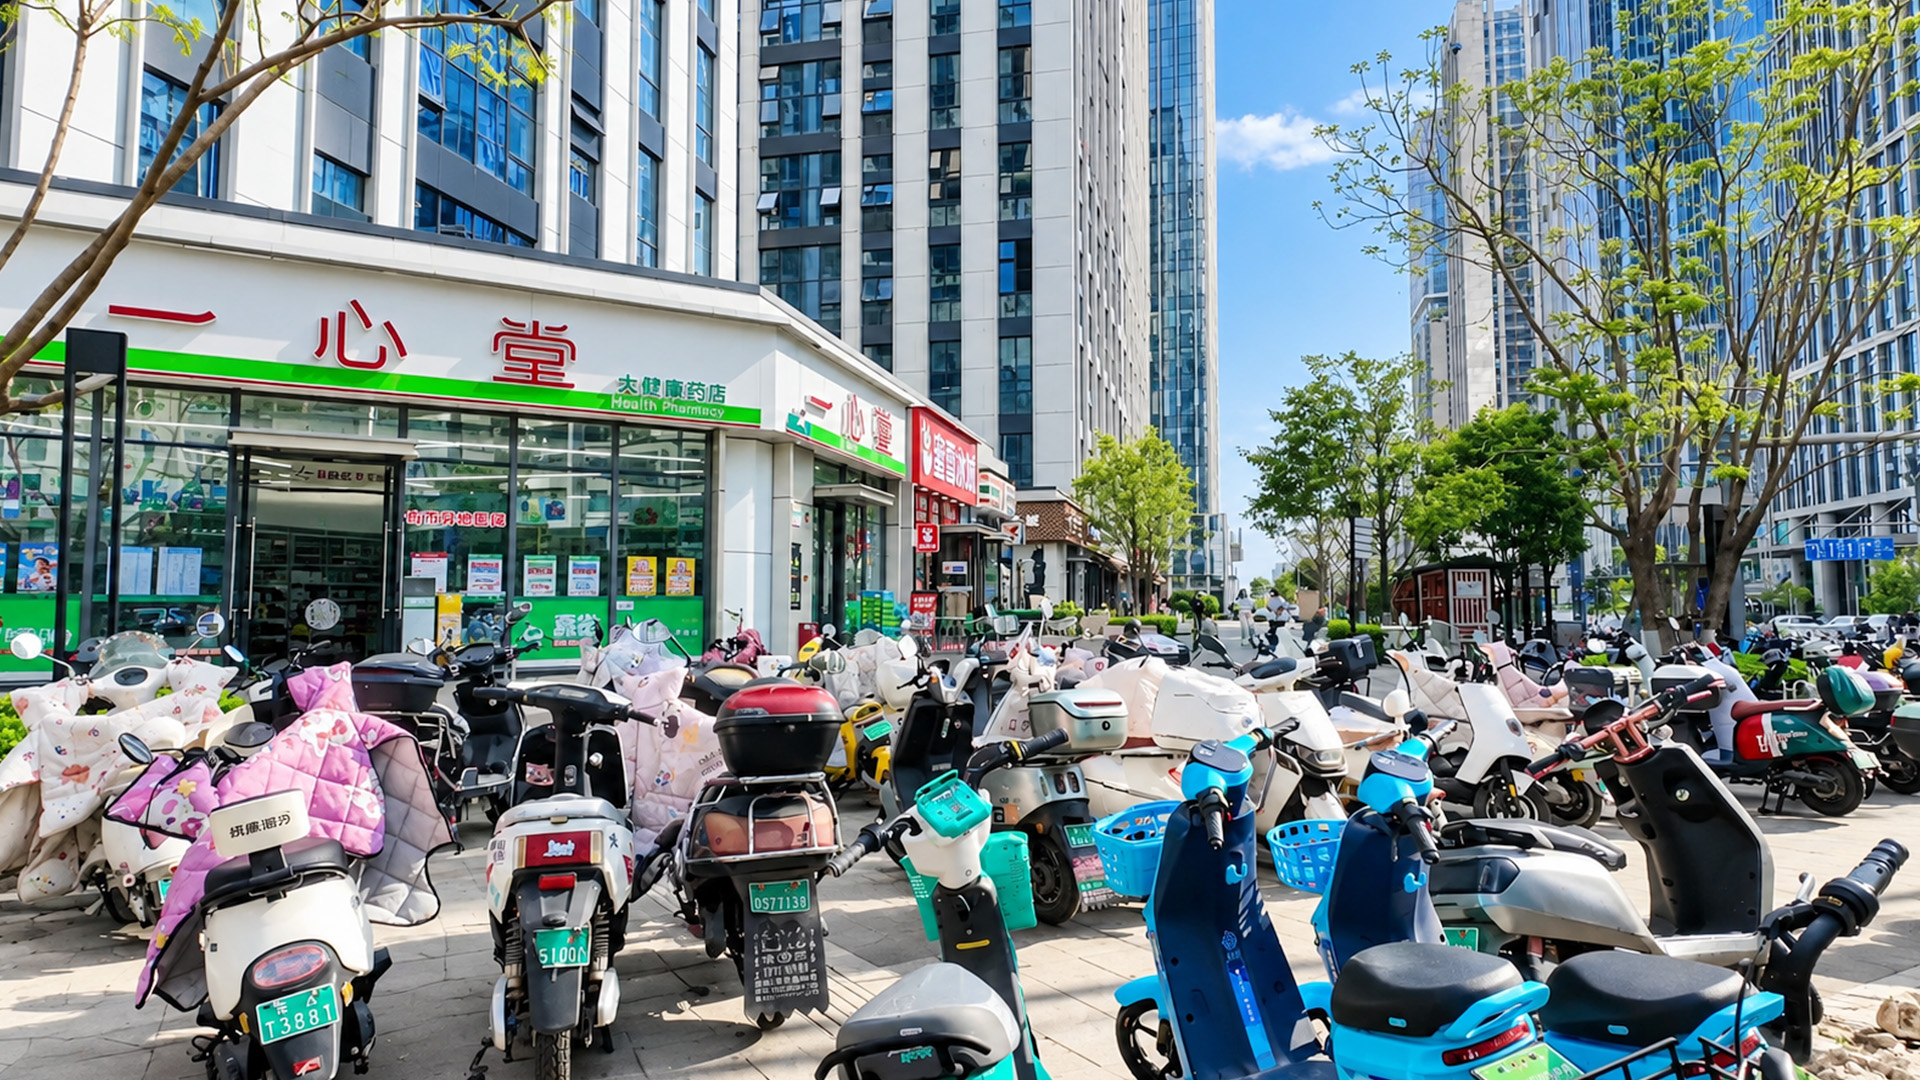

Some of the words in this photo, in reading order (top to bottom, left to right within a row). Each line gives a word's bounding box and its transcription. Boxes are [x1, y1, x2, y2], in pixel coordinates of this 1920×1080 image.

[108, 299, 577, 389] 一心堂
[617, 374, 727, 404] 大健康药店
[265, 1004, 332, 1038] T3881
